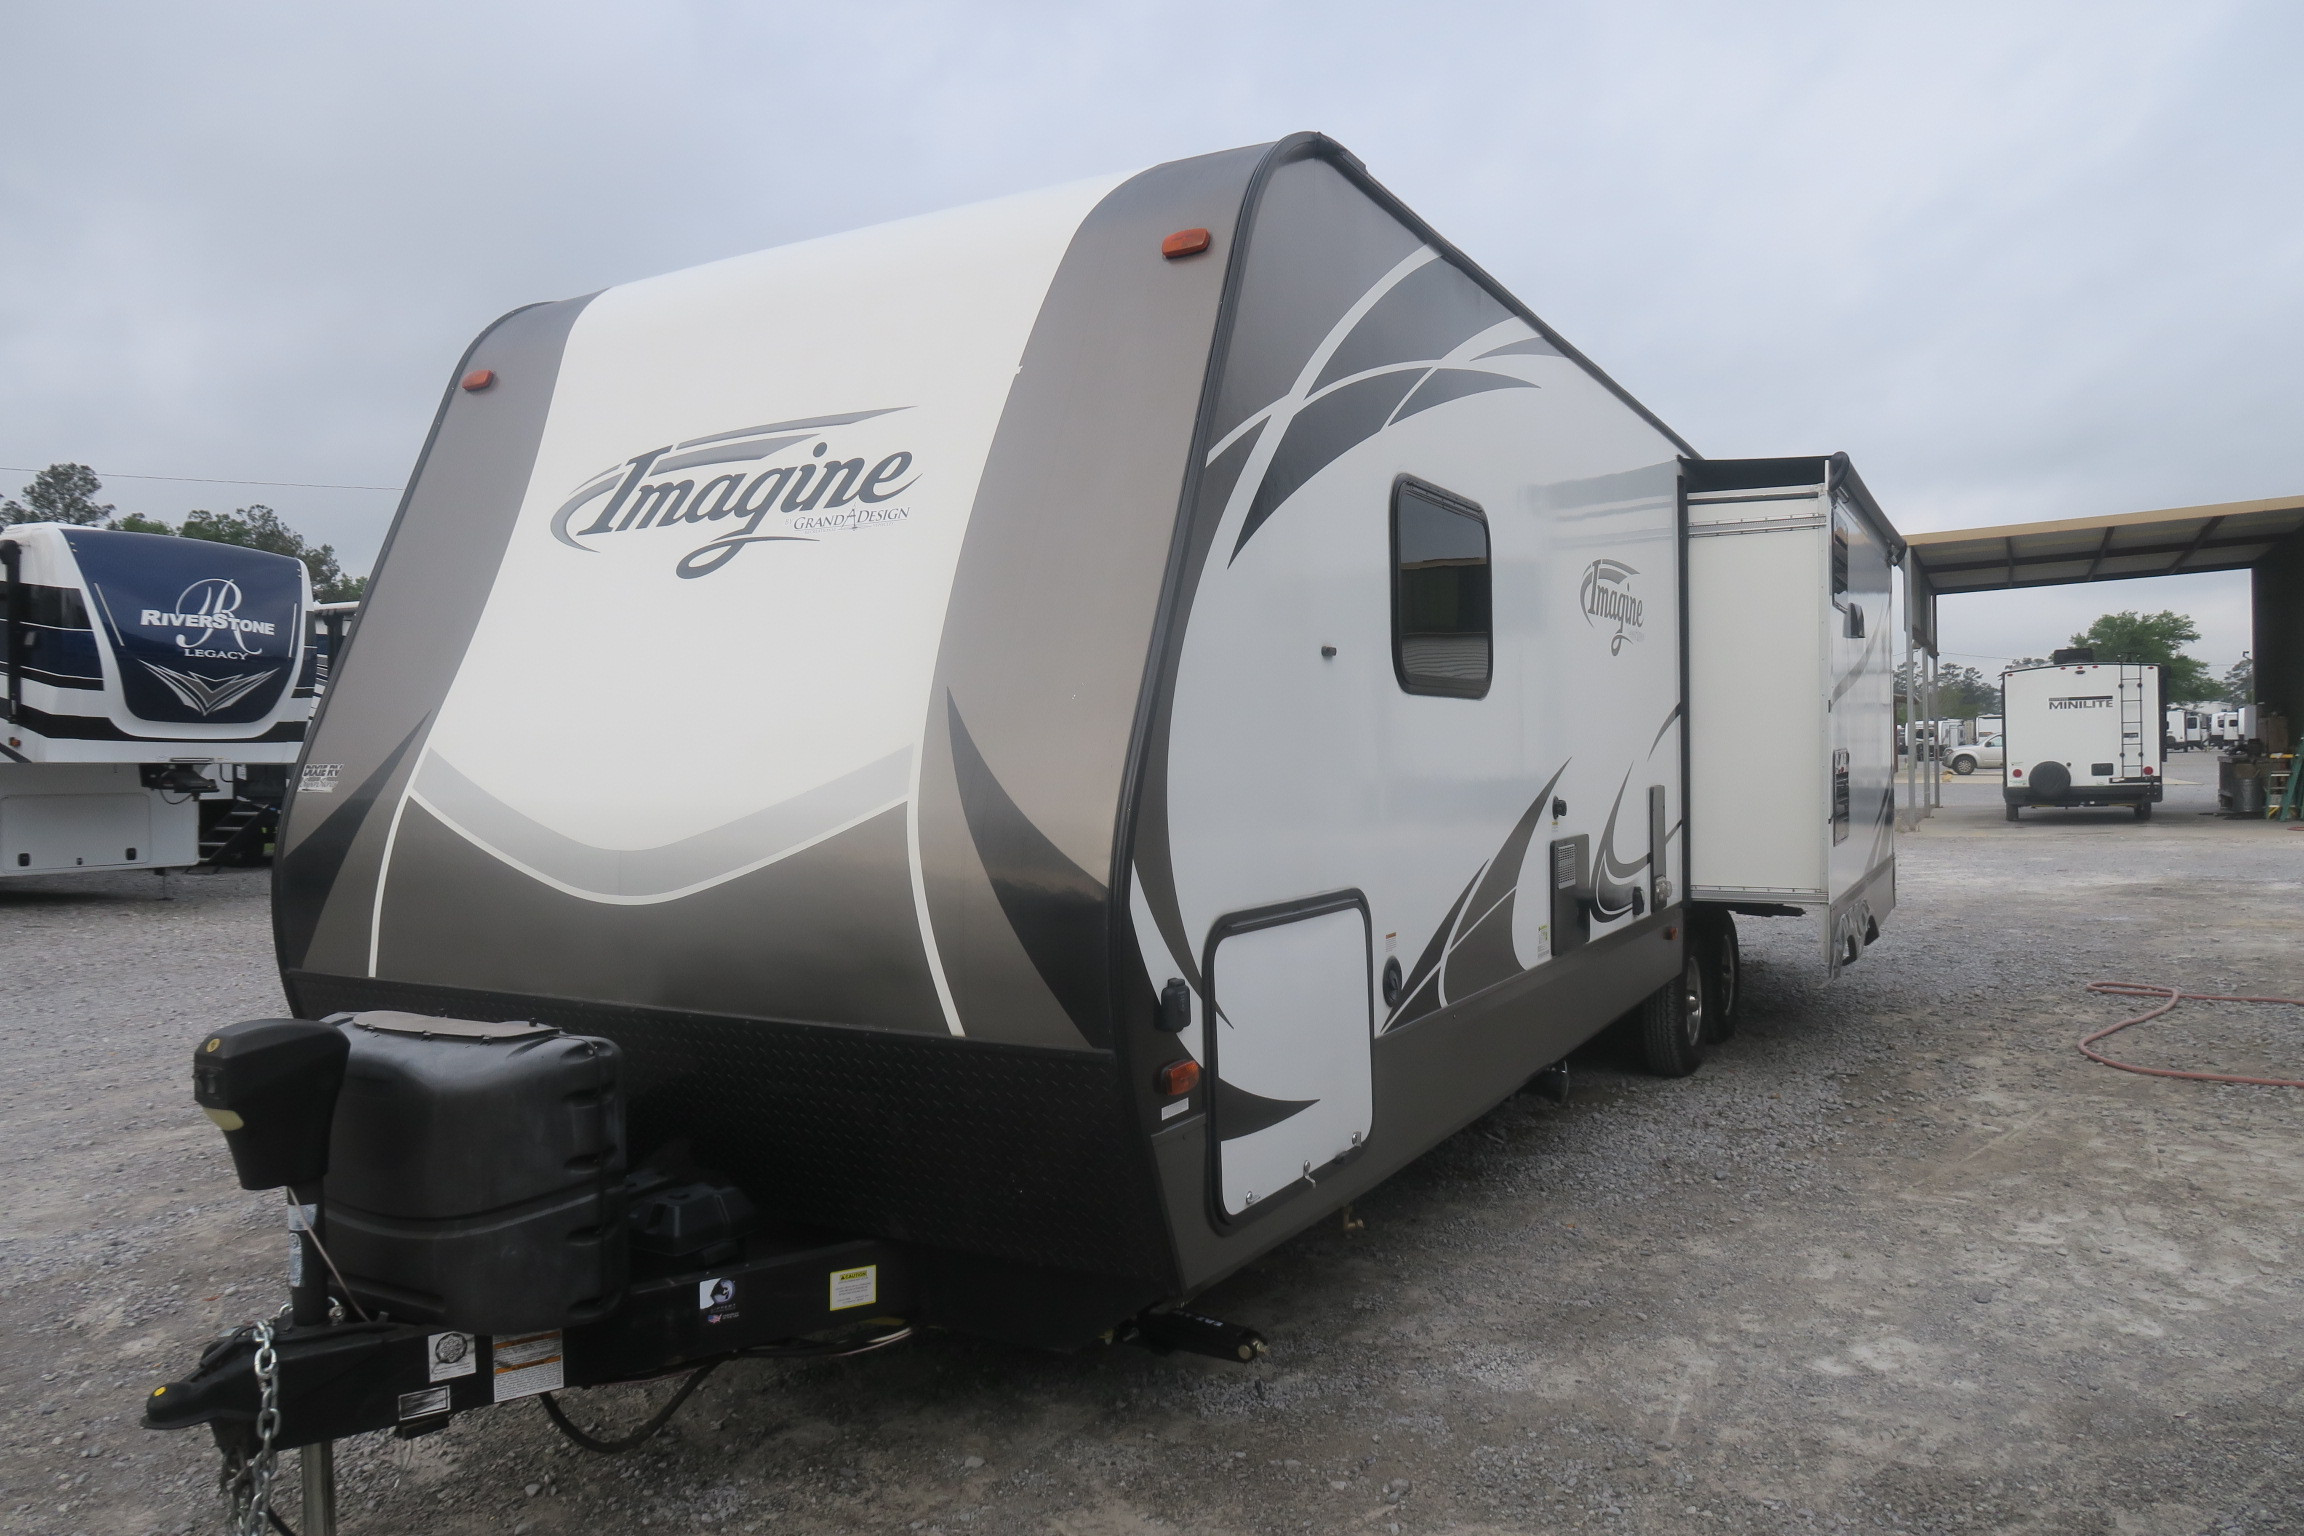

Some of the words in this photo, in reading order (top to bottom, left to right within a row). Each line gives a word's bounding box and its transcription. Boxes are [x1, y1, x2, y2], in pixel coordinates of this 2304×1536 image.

[576, 441, 923, 579] Imagine
[793, 513, 844, 530] GRAND
[857, 507, 910, 523] DESIGN
[1588, 558, 1645, 656] Imagine
[184, 648, 249, 660] LEGACY
[2048, 699, 2114, 710] MINILITE
[845, 1271, 866, 1280] CAUTION
